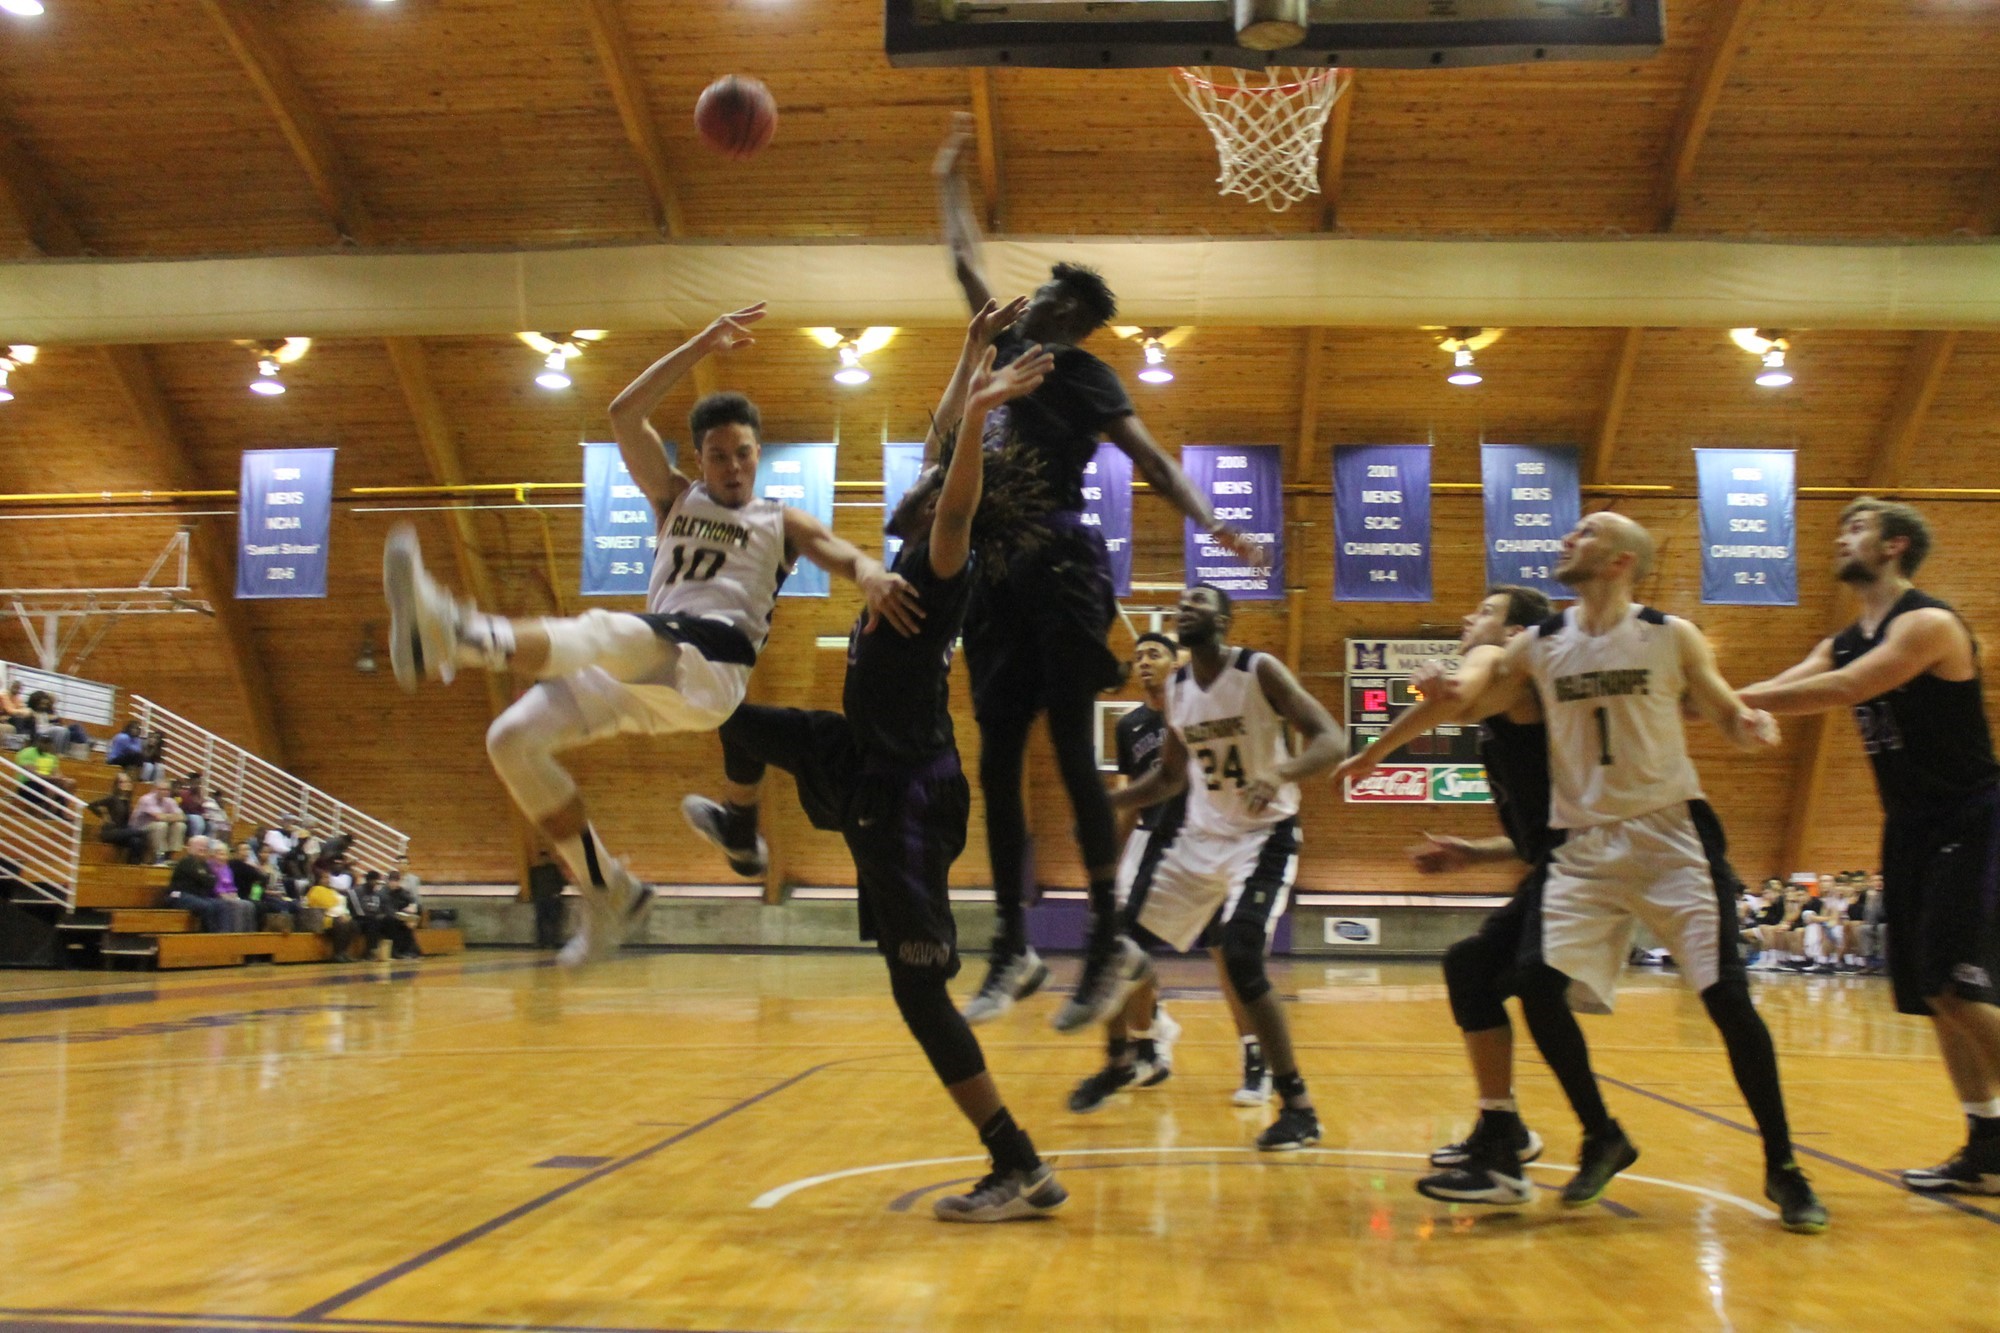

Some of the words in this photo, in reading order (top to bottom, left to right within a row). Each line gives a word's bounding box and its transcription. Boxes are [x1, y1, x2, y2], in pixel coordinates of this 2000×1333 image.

[610, 510, 648, 524] NCAA
[1213, 507, 1253, 520] SCAC
[1514, 513, 1552, 527] SCAC
[1364, 516, 1402, 530] SCAC
[1729, 518, 1767, 533] SCAC
[1344, 542, 1422, 556] CHAMPIONS
[1494, 539, 1564, 553] CHAMPION
[1710, 544, 1789, 559] CHAMPIONS
[666, 545, 727, 585] 10
[1733, 571, 1767, 584] 12-2
[1594, 706, 1615, 766] 1
[1197, 744, 1247, 791] 24
